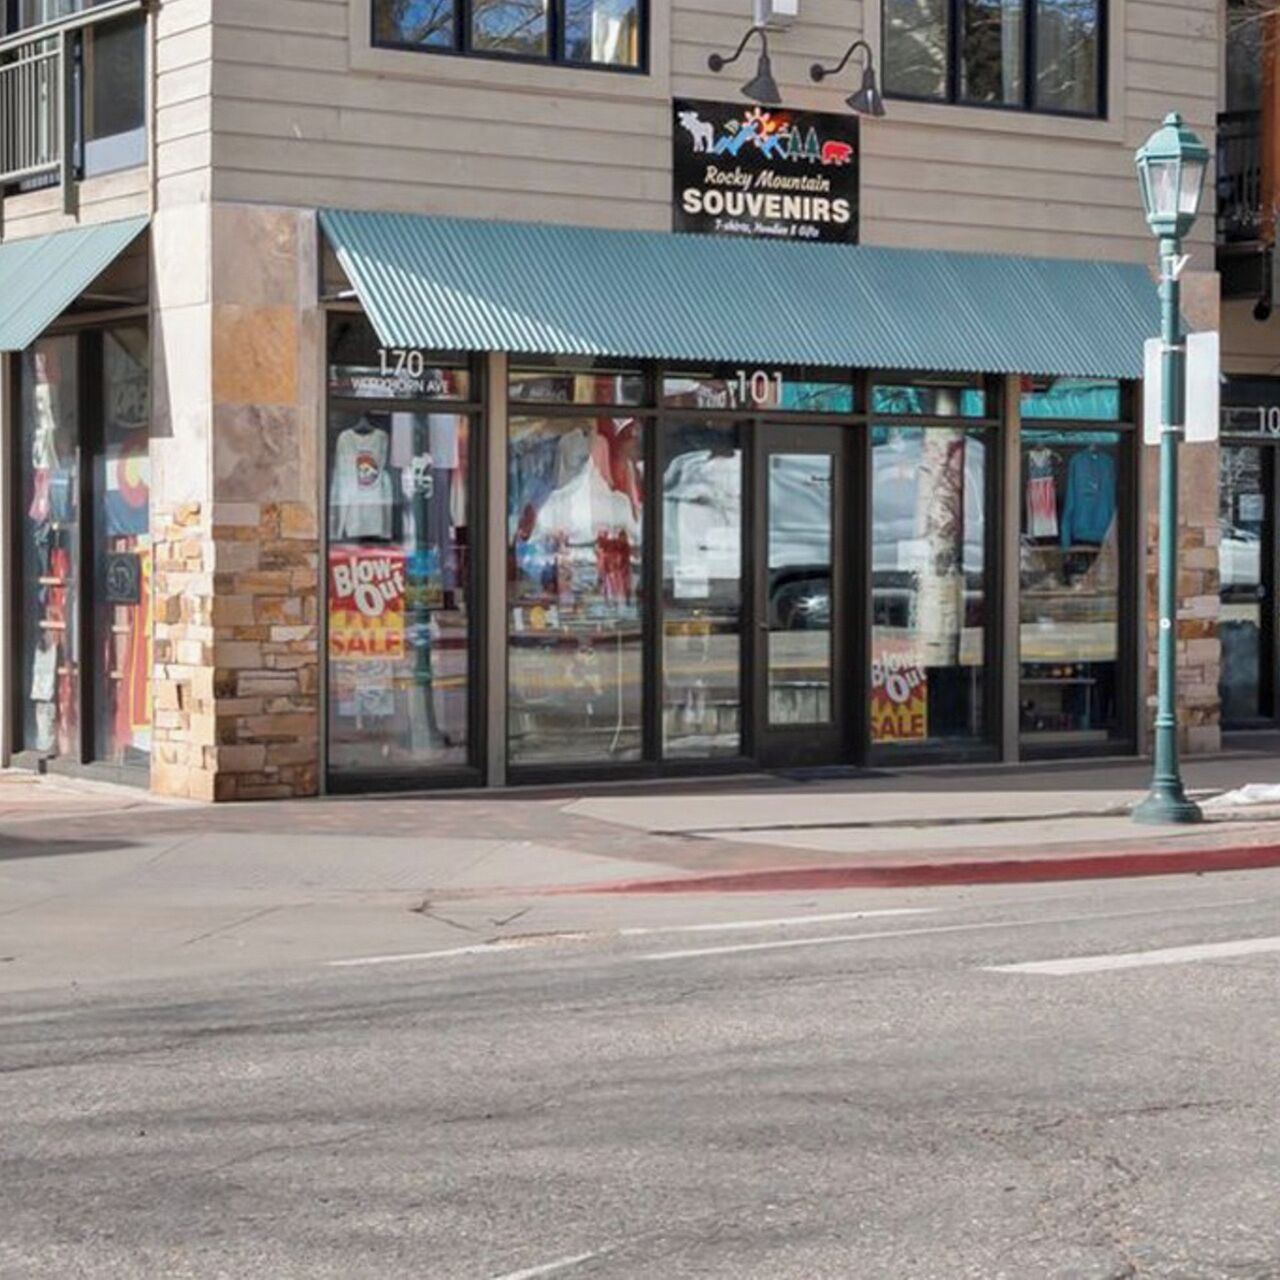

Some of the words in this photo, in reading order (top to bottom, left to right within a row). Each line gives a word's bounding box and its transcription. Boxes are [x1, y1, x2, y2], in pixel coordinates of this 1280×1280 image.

[705, 166, 752, 190] Rocky
[754, 171, 830, 191] Mountain
[682, 188, 850, 223] SOUVENIRS
[377, 349, 424, 378] 170
[736, 370, 783, 406] 101
[354, 571, 405, 617] Out
[331, 631, 402, 653] SALE
[871, 714, 925, 738] SALE
